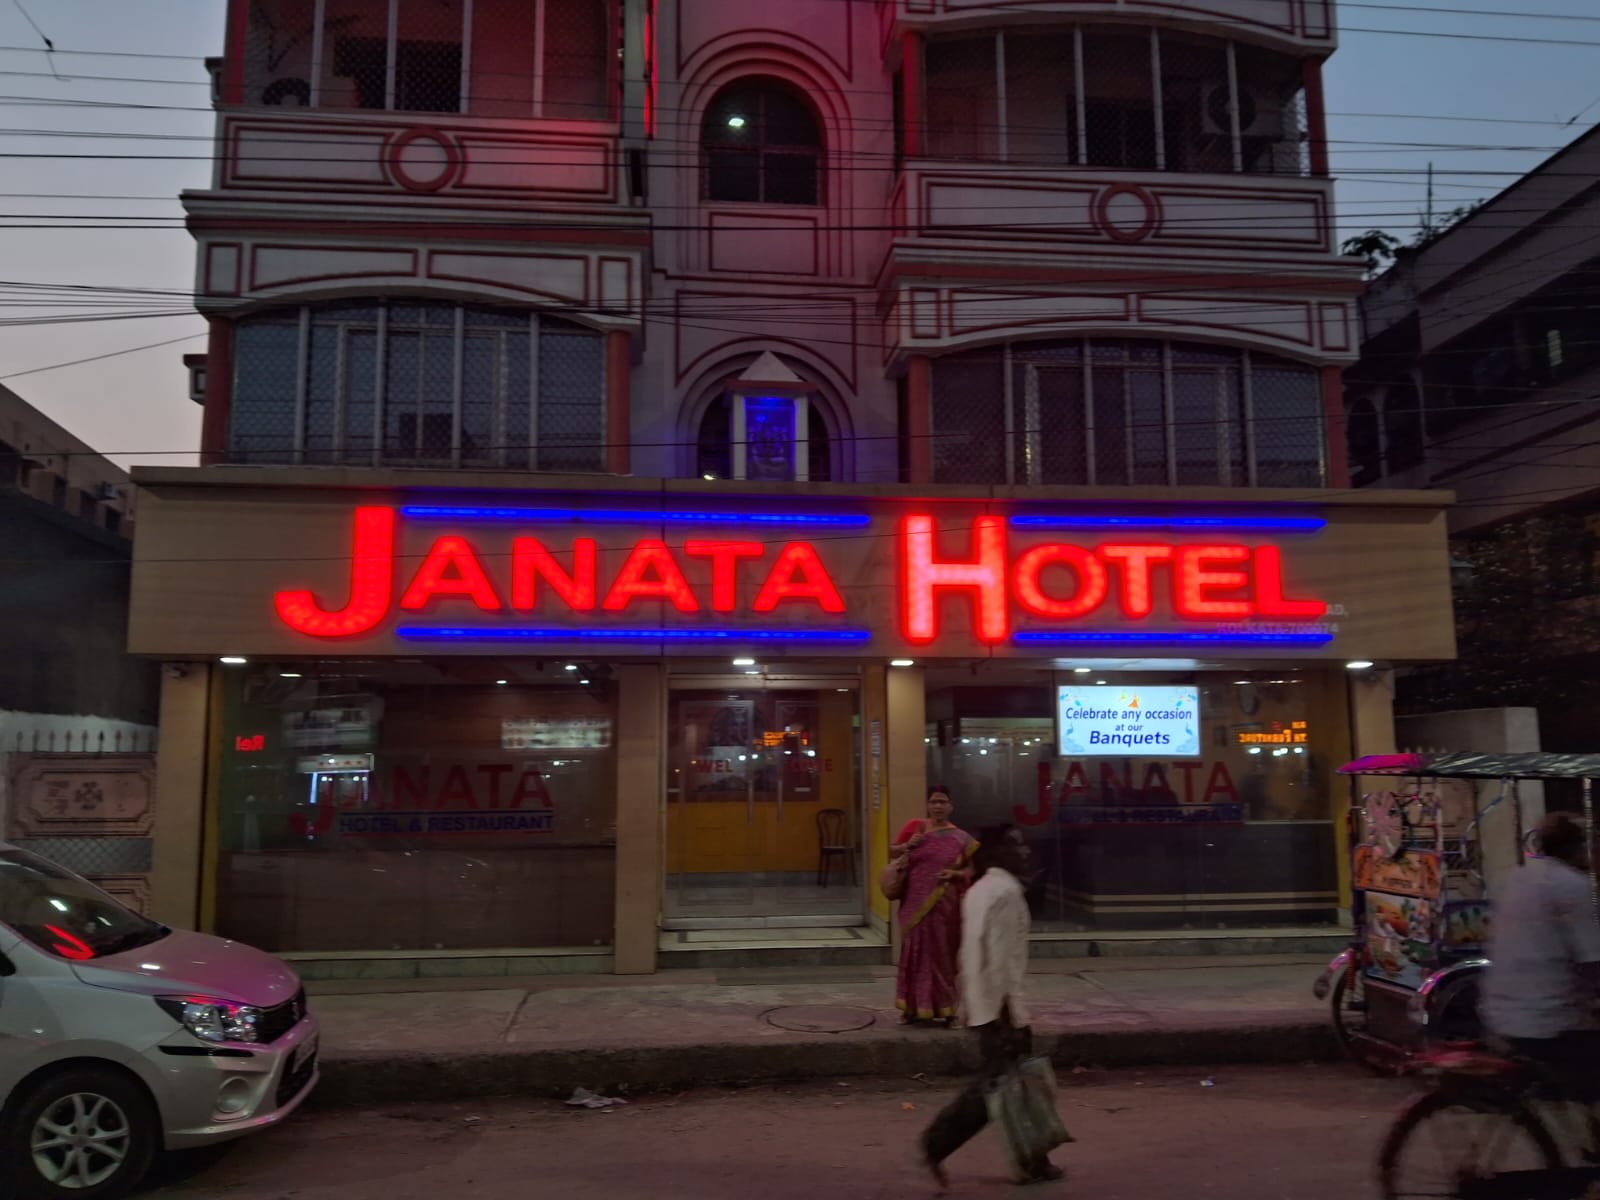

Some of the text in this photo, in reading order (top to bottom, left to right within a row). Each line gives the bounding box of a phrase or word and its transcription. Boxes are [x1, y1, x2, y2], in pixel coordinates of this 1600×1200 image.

[274, 506, 1328, 643] JANATA HOTEL
[1066, 707, 1192, 722] Celebrate any occasion
[1115, 723, 1144, 732] at our
[1090, 730, 1171, 747] Banquets
[288, 764, 553, 834] JANATA
[1013, 761, 1239, 827] JANATA
[339, 816, 402, 833] HOTEL
[428, 815, 553, 832] RESTAURANT
